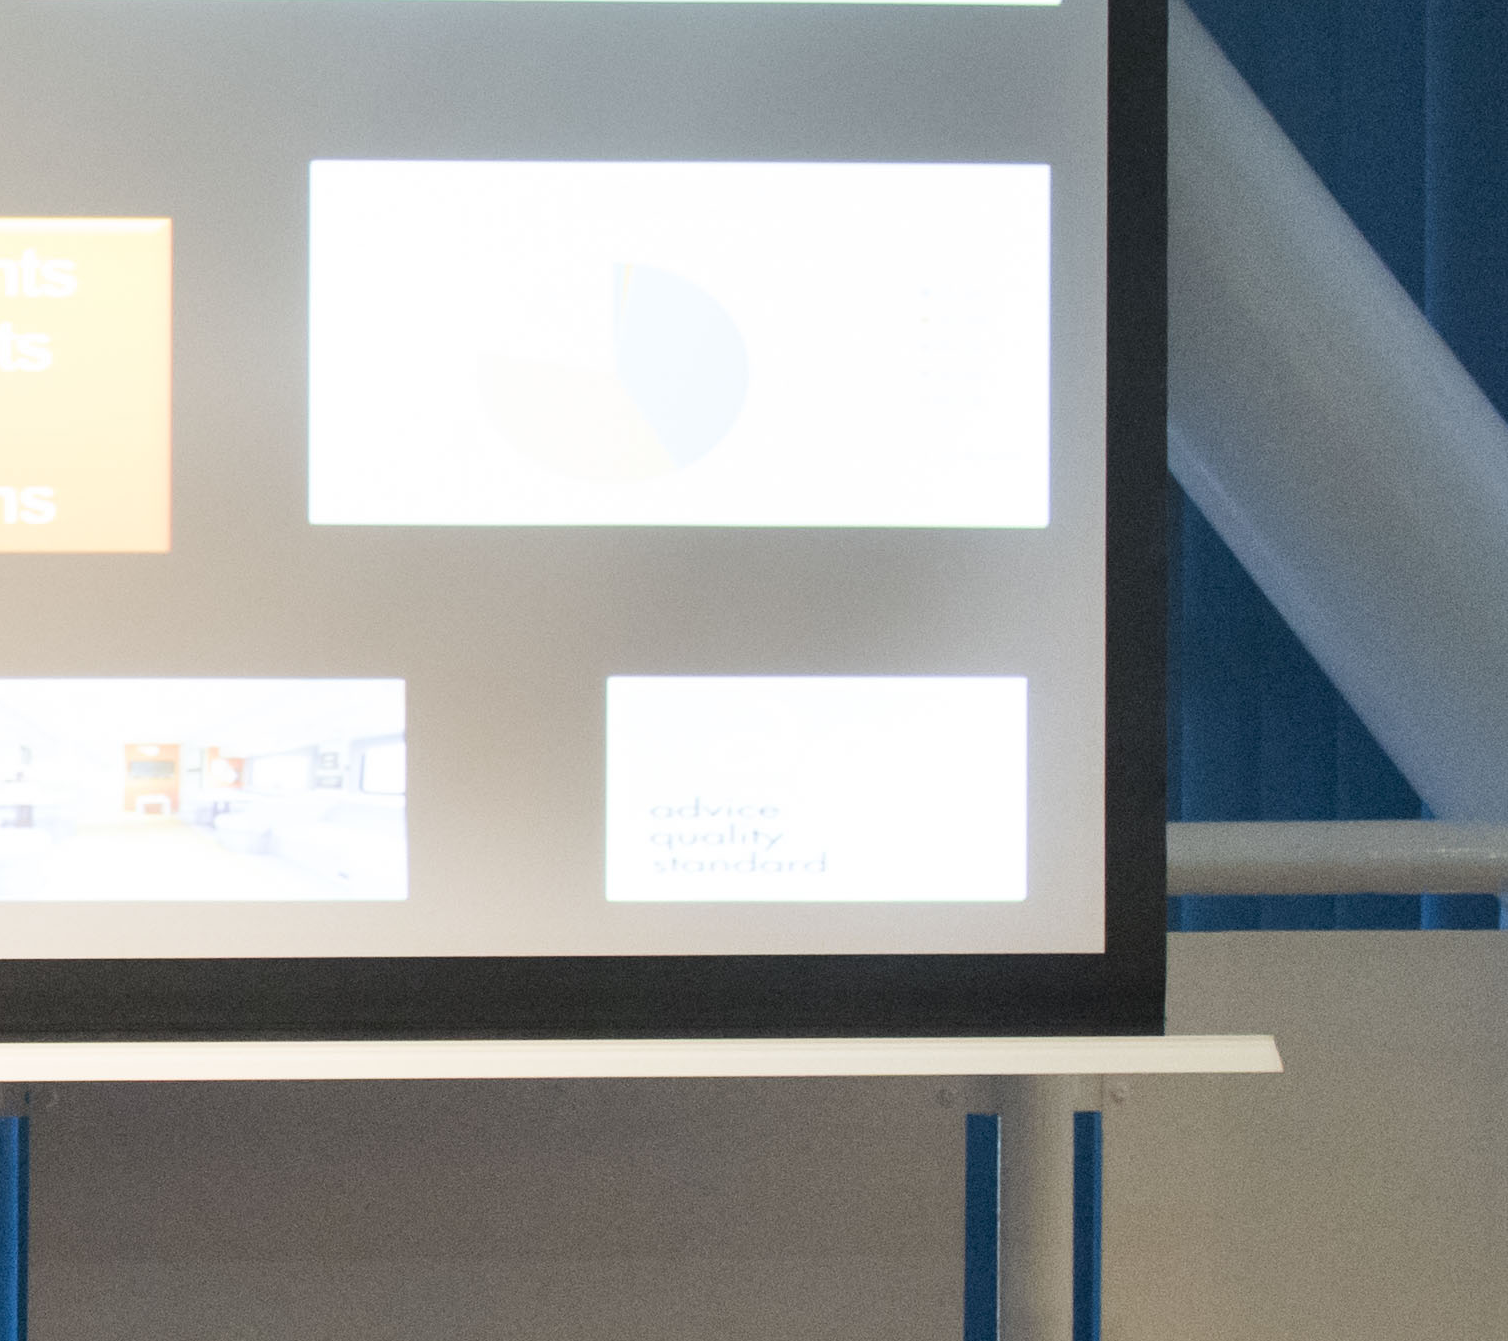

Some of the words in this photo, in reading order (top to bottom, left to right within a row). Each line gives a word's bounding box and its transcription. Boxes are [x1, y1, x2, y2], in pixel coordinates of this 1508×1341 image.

[648, 795, 782, 820] advice
[648, 823, 785, 853] quality
[652, 849, 828, 876] standard
